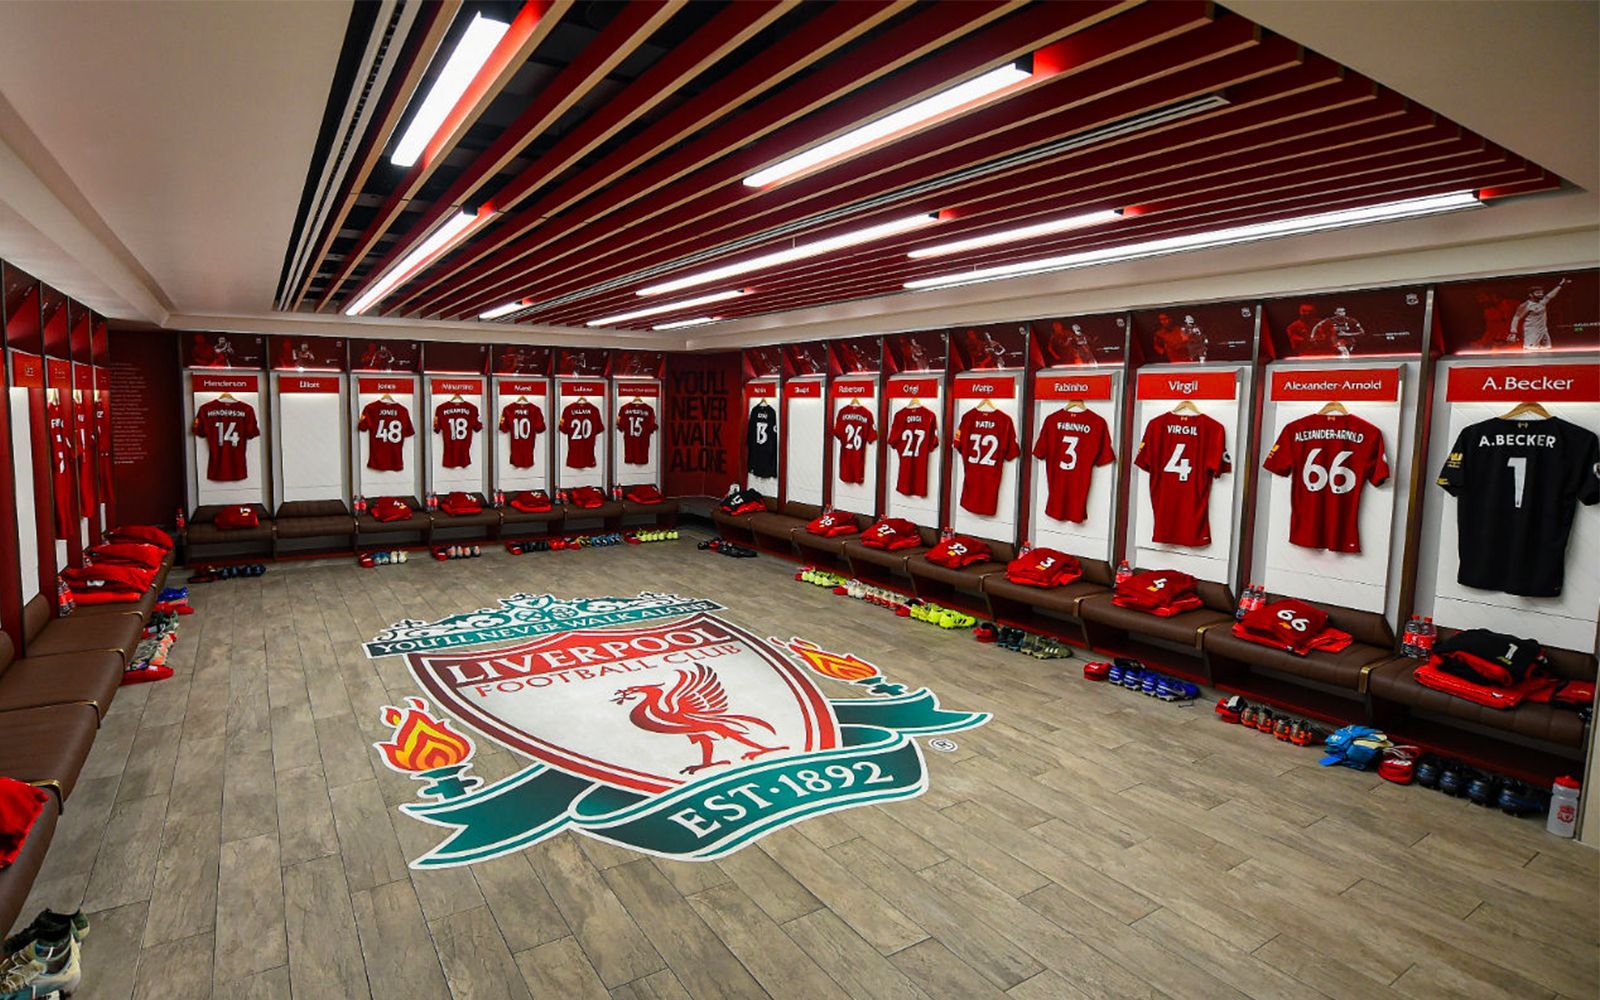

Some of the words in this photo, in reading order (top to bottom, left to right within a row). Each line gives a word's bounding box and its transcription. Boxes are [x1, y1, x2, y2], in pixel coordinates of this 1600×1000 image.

[203, 379, 247, 388] Henderson
[377, 382, 396, 391] Jones
[441, 383, 474, 391] Minamino
[972, 383, 993, 395] Matip
[1054, 382, 1088, 392] Fabinho
[1168, 380, 1198, 394] Virgil
[1283, 378, 1382, 392] Alexander-Arnold
[378, 409, 398, 417] JONES
[671, 396, 728, 421] NEVER
[215, 421, 240, 447] 14
[375, 419, 402, 444] 48
[448, 417, 468, 441] 18
[512, 417, 531, 440] 10
[570, 418, 592, 441] 20
[629, 416, 644, 437] 15
[671, 421, 722, 448] WALK
[756, 422, 768, 445] 13
[845, 423, 862, 451] 26
[1057, 421, 1091, 433] FABINHO
[1166, 424, 1198, 437] VIRGIL
[1293, 428, 1365, 444] ALEXANDER-ARNOLD
[901, 429, 926, 458] 27
[968, 433, 999, 467] 32
[1478, 434, 1557, 448] A.BECKER
[670, 447, 728, 475] ALONE
[1059, 435, 1080, 471] 3
[1163, 443, 1192, 482] 4
[1302, 447, 1357, 495] 66
[1507, 457, 1527, 508] 1
[877, 523, 896, 535] 27
[1039, 556, 1056, 569] 3
[376, 634, 474, 654] YOU'LL
[479, 622, 562, 641] NEVER
[564, 613, 632, 628] WALK
[641, 602, 714, 618] ALONE
[1277, 609, 1310, 632] 66
[446, 627, 732, 685] LIVERPOOL
[1505, 643, 1519, 660] 1
[475, 659, 658, 698] FOOTBALL
[663, 643, 742, 664] CLUB
